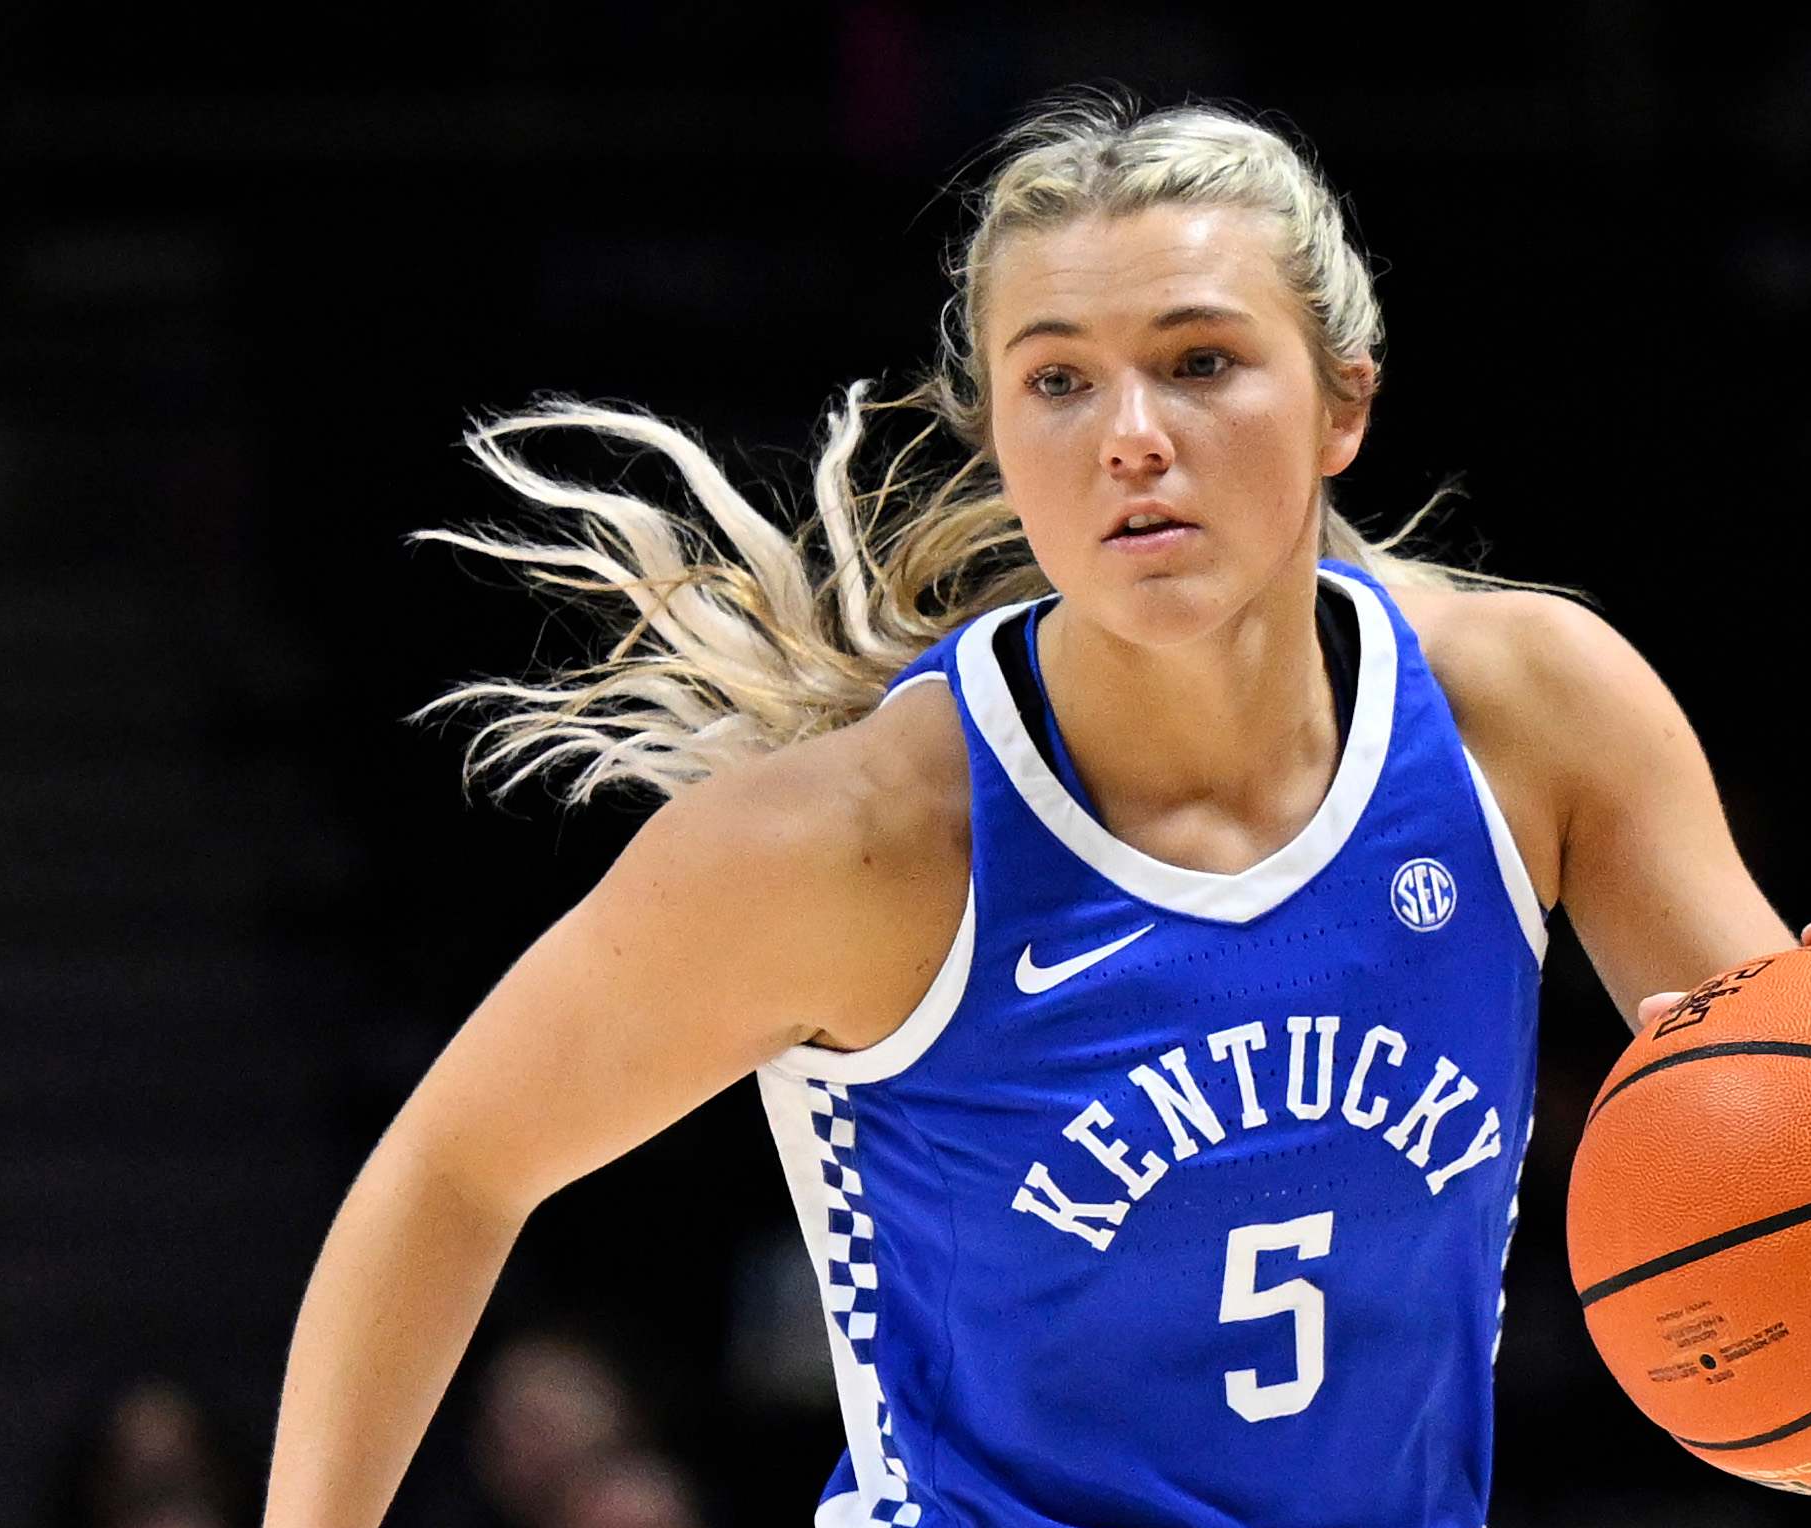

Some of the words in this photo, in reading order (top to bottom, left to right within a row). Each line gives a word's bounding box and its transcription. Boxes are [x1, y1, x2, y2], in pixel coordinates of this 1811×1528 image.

[1396, 864, 1451, 924] SEC
[1011, 1015, 1504, 1253] KENTUCKY
[1218, 1210, 1335, 1424] 5
